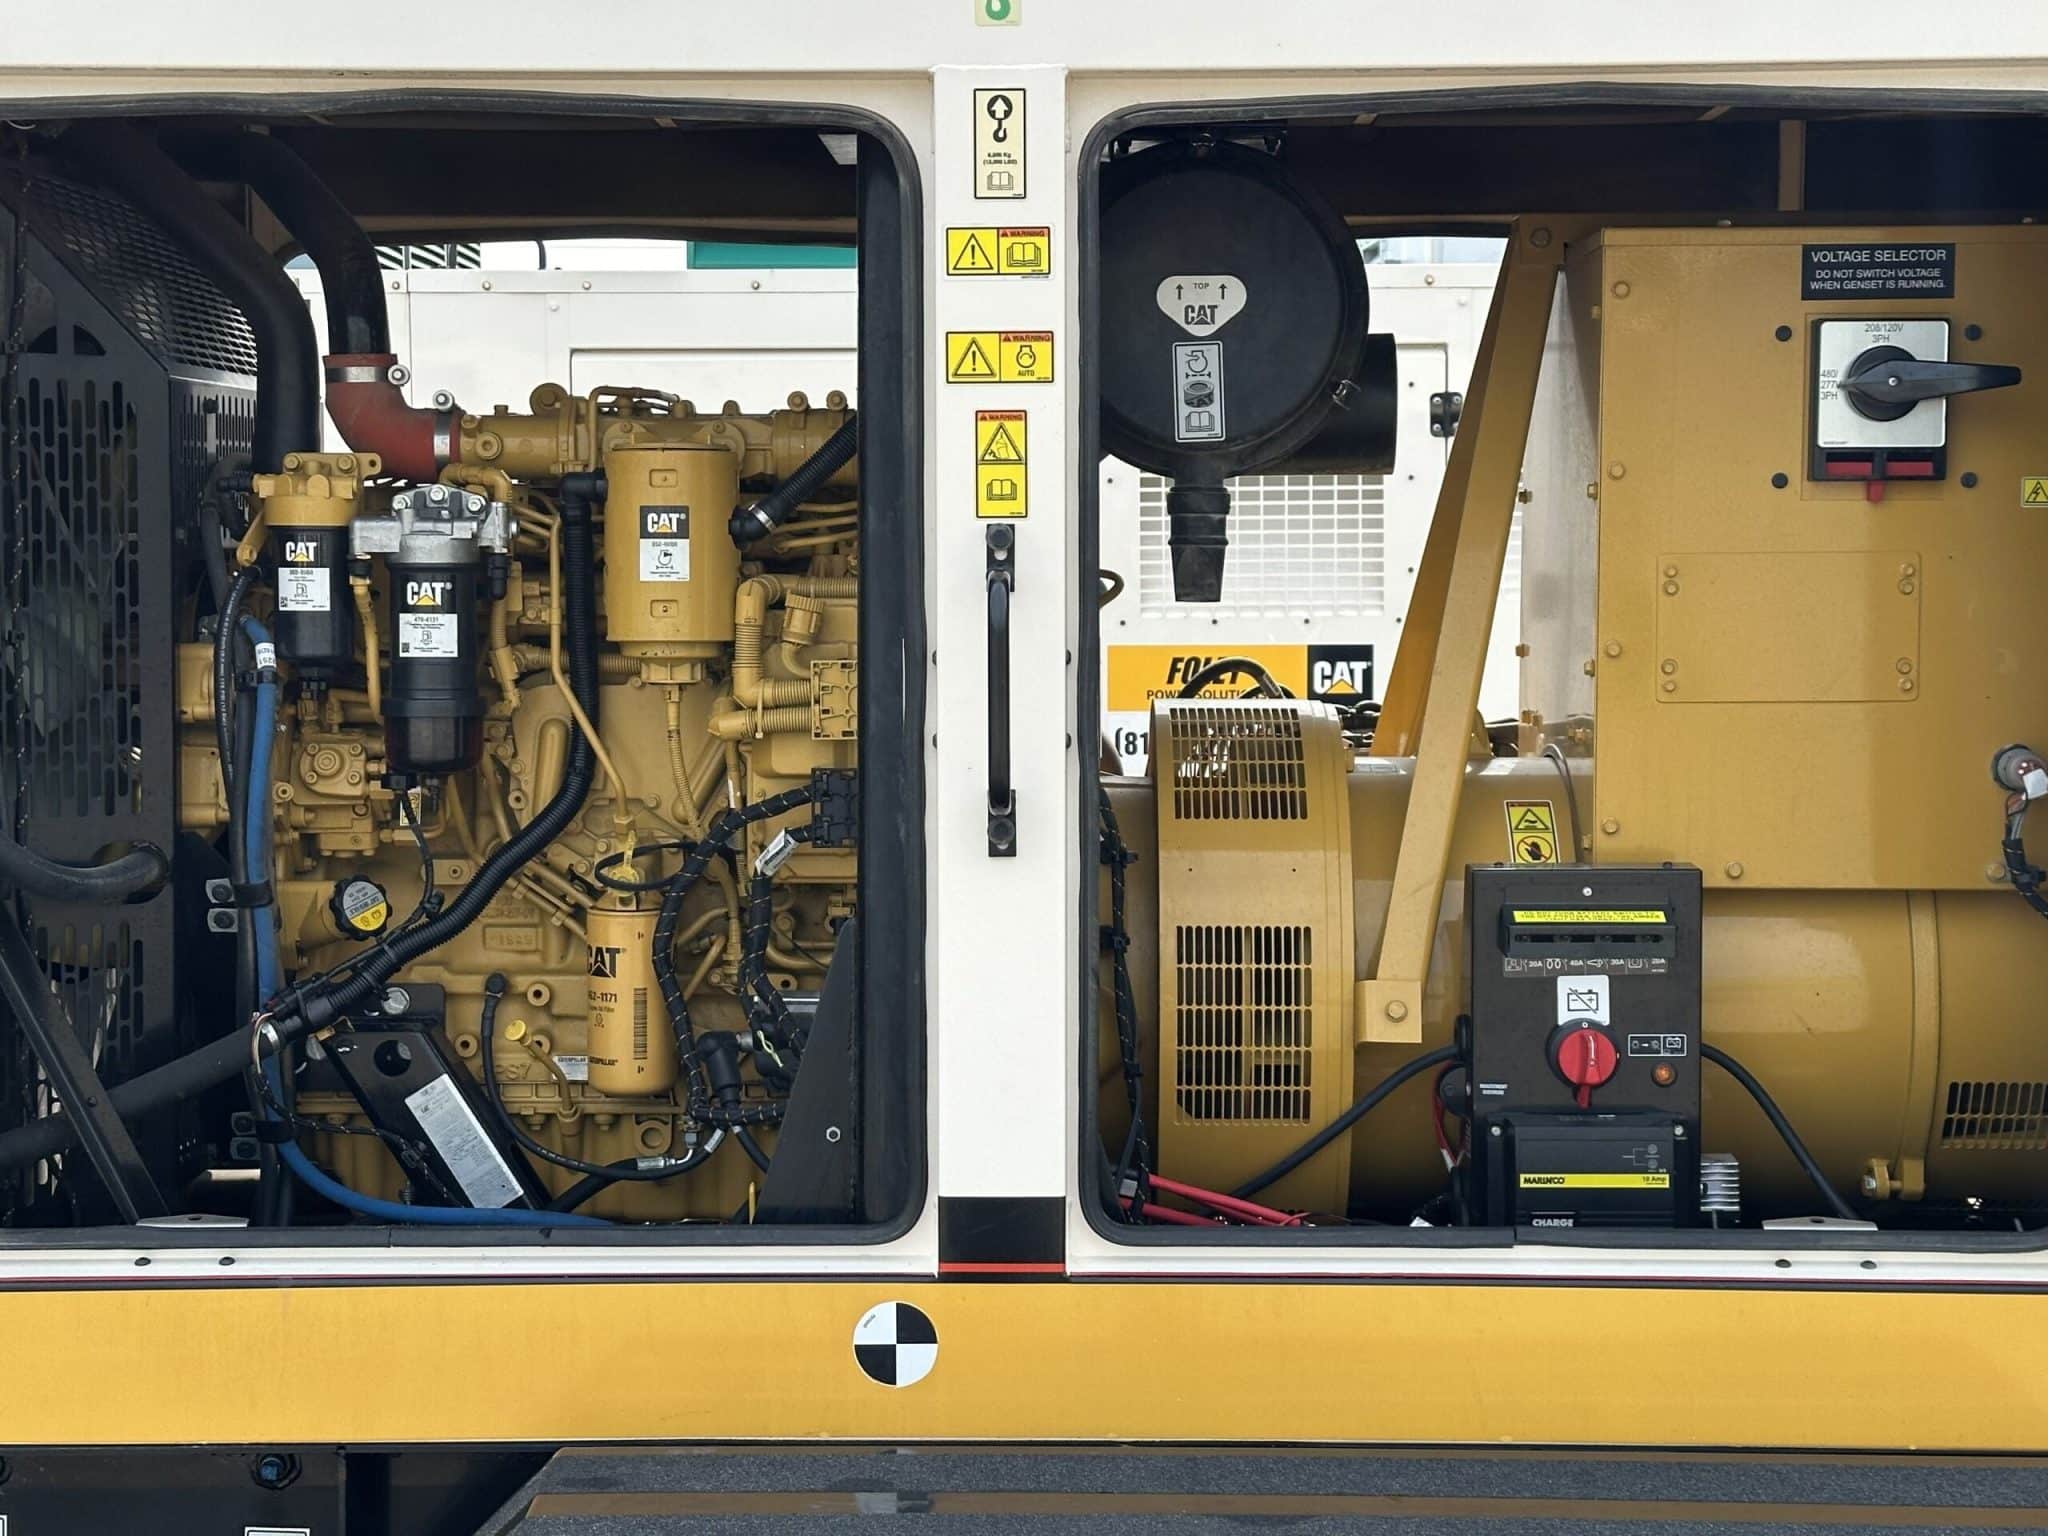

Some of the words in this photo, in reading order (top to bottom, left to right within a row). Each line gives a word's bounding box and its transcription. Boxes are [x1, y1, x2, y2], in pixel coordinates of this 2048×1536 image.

[1811, 250, 1871, 262] VOLTAGE
[1874, 249, 1947, 261] SELECTOR
[1815, 269, 1832, 278] DO
[1833, 269, 1853, 278] NOT
[1856, 269, 1895, 278] SWITCH
[1897, 268, 1941, 277] VOLTAGE
[1810, 281, 1841, 289] WHEN
[1843, 280, 1883, 289] GENSET
[1886, 280, 1896, 288] IS
[1899, 279, 1946, 288] RUNNING.
[1184, 304, 1219, 326] CAT
[1864, 323, 1904, 333] 208/120V
[1872, 334, 1890, 343] 3PH
[1017, 369, 1035, 377] AUTO
[1820, 391, 1838, 400] 3PH
[647, 512, 680, 533] CAT
[285, 541, 317, 561] CAT
[406, 581, 445, 606] CAT
[1312, 661, 1368, 694] CAT
[588, 944, 621, 978] CAT
[587, 990, 617, 1003] 62-1171
[1651, 1175, 1666, 1183] Amp
[1532, 1218, 1574, 1227] CHARGE
